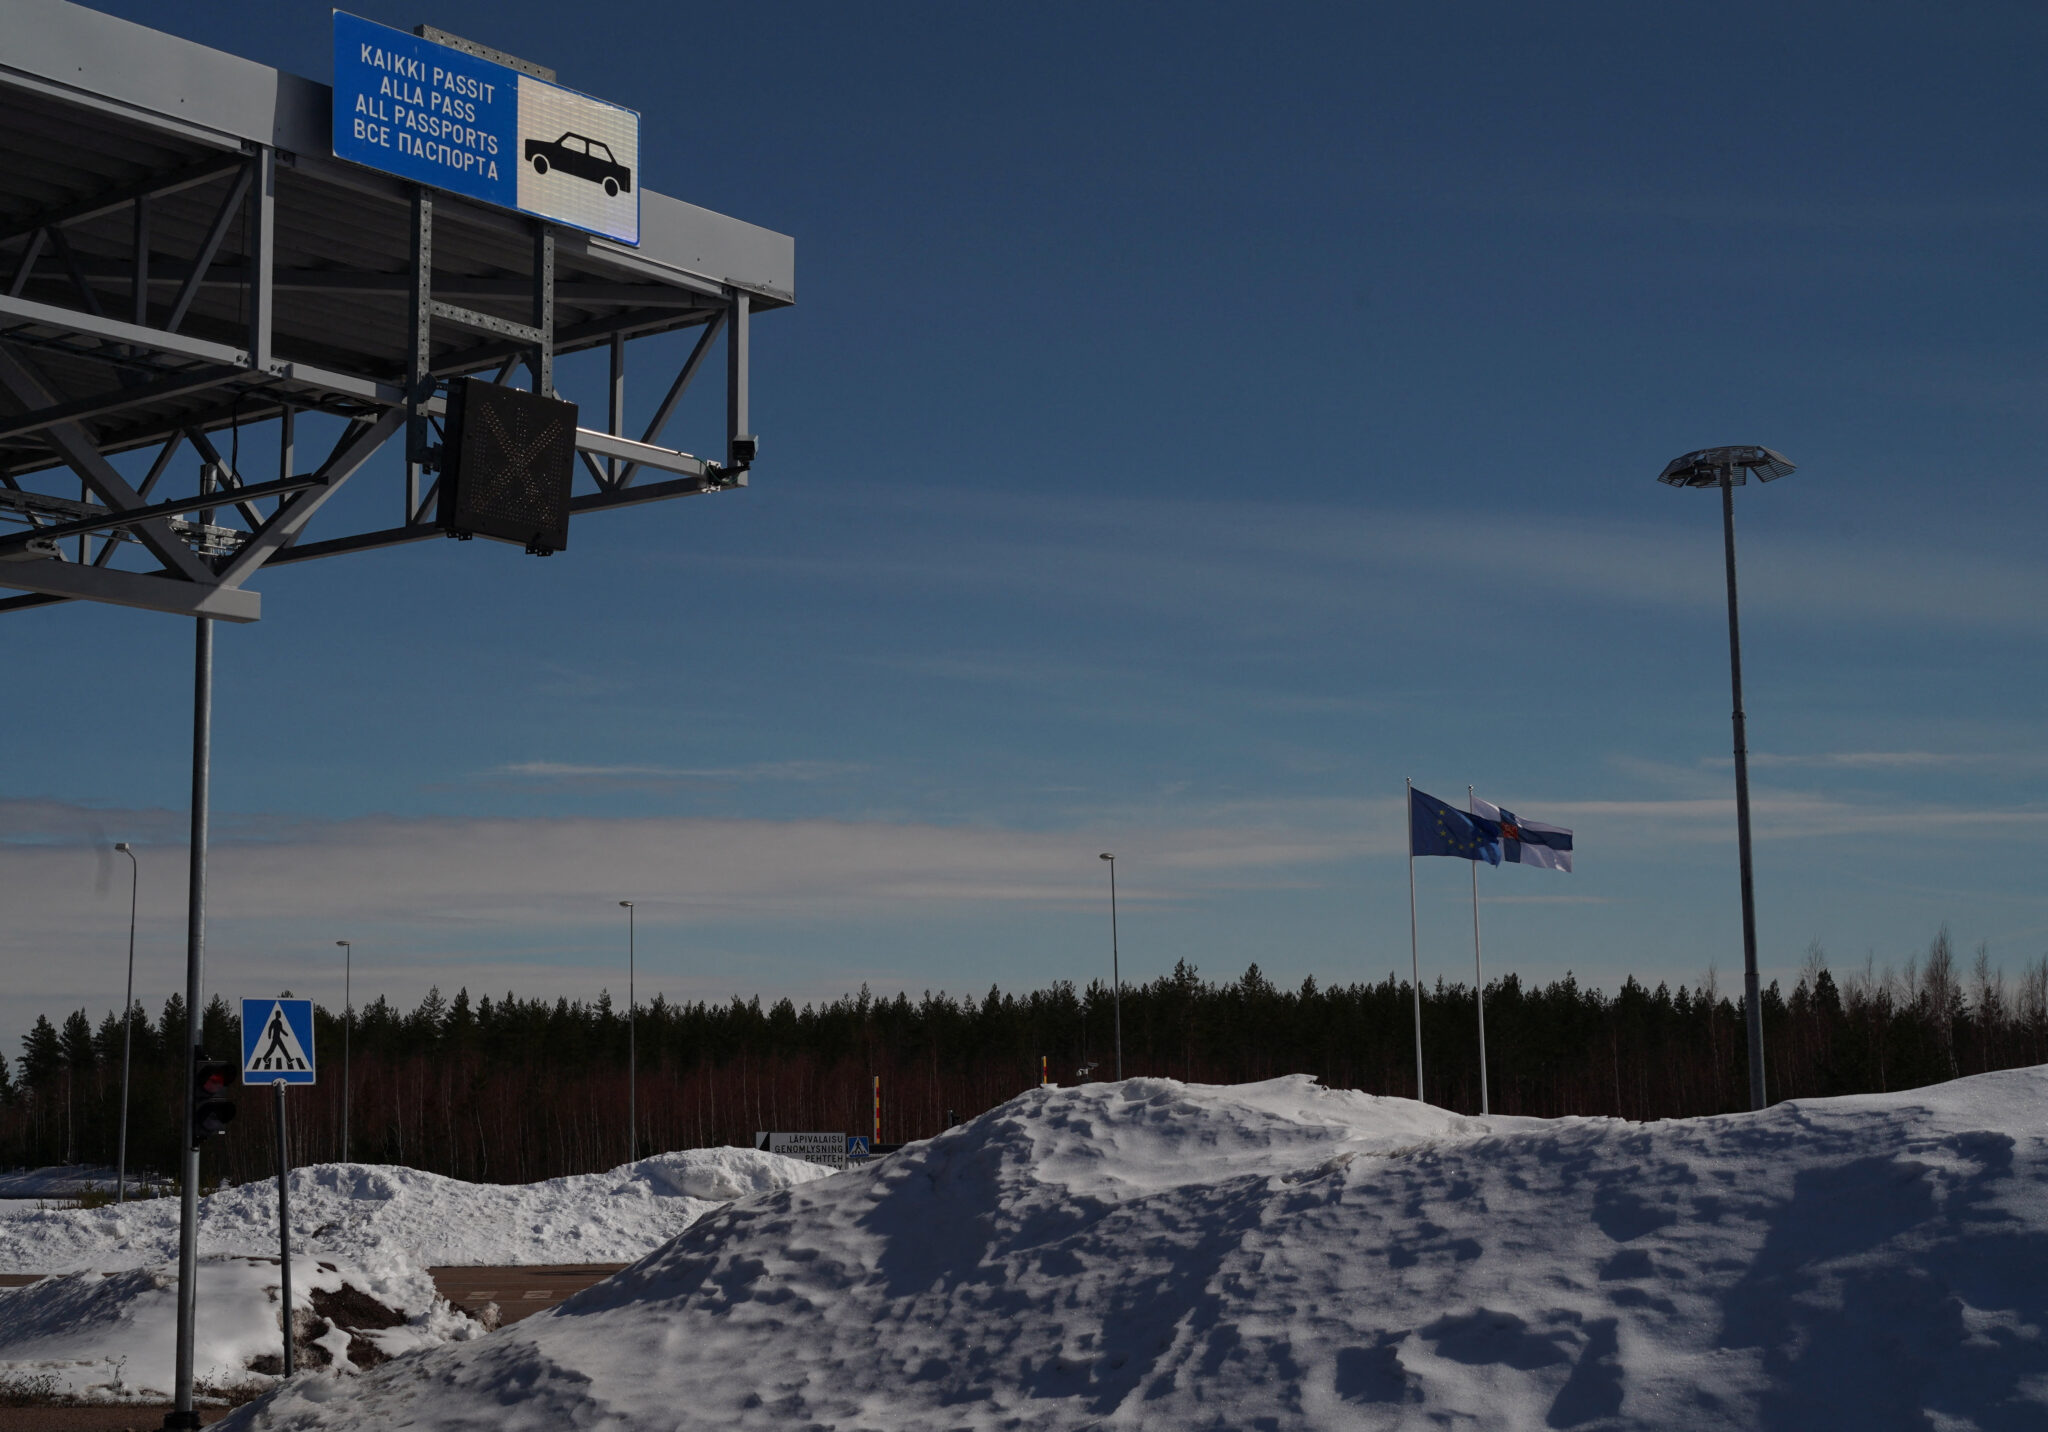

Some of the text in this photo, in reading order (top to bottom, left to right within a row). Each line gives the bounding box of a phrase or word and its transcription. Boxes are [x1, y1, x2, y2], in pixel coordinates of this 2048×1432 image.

[361, 43, 495, 104] KAIKKI PASSIT
[380, 76, 475, 123] ALLA PASS
[354, 118, 498, 181] ВСЕ ПАСПОРТА
[355, 94, 498, 155] ALL PASSPORTS
[774, 1145, 843, 1153] GENOMLYSNING
[789, 1134, 843, 1143] LÄPIVALAISU
